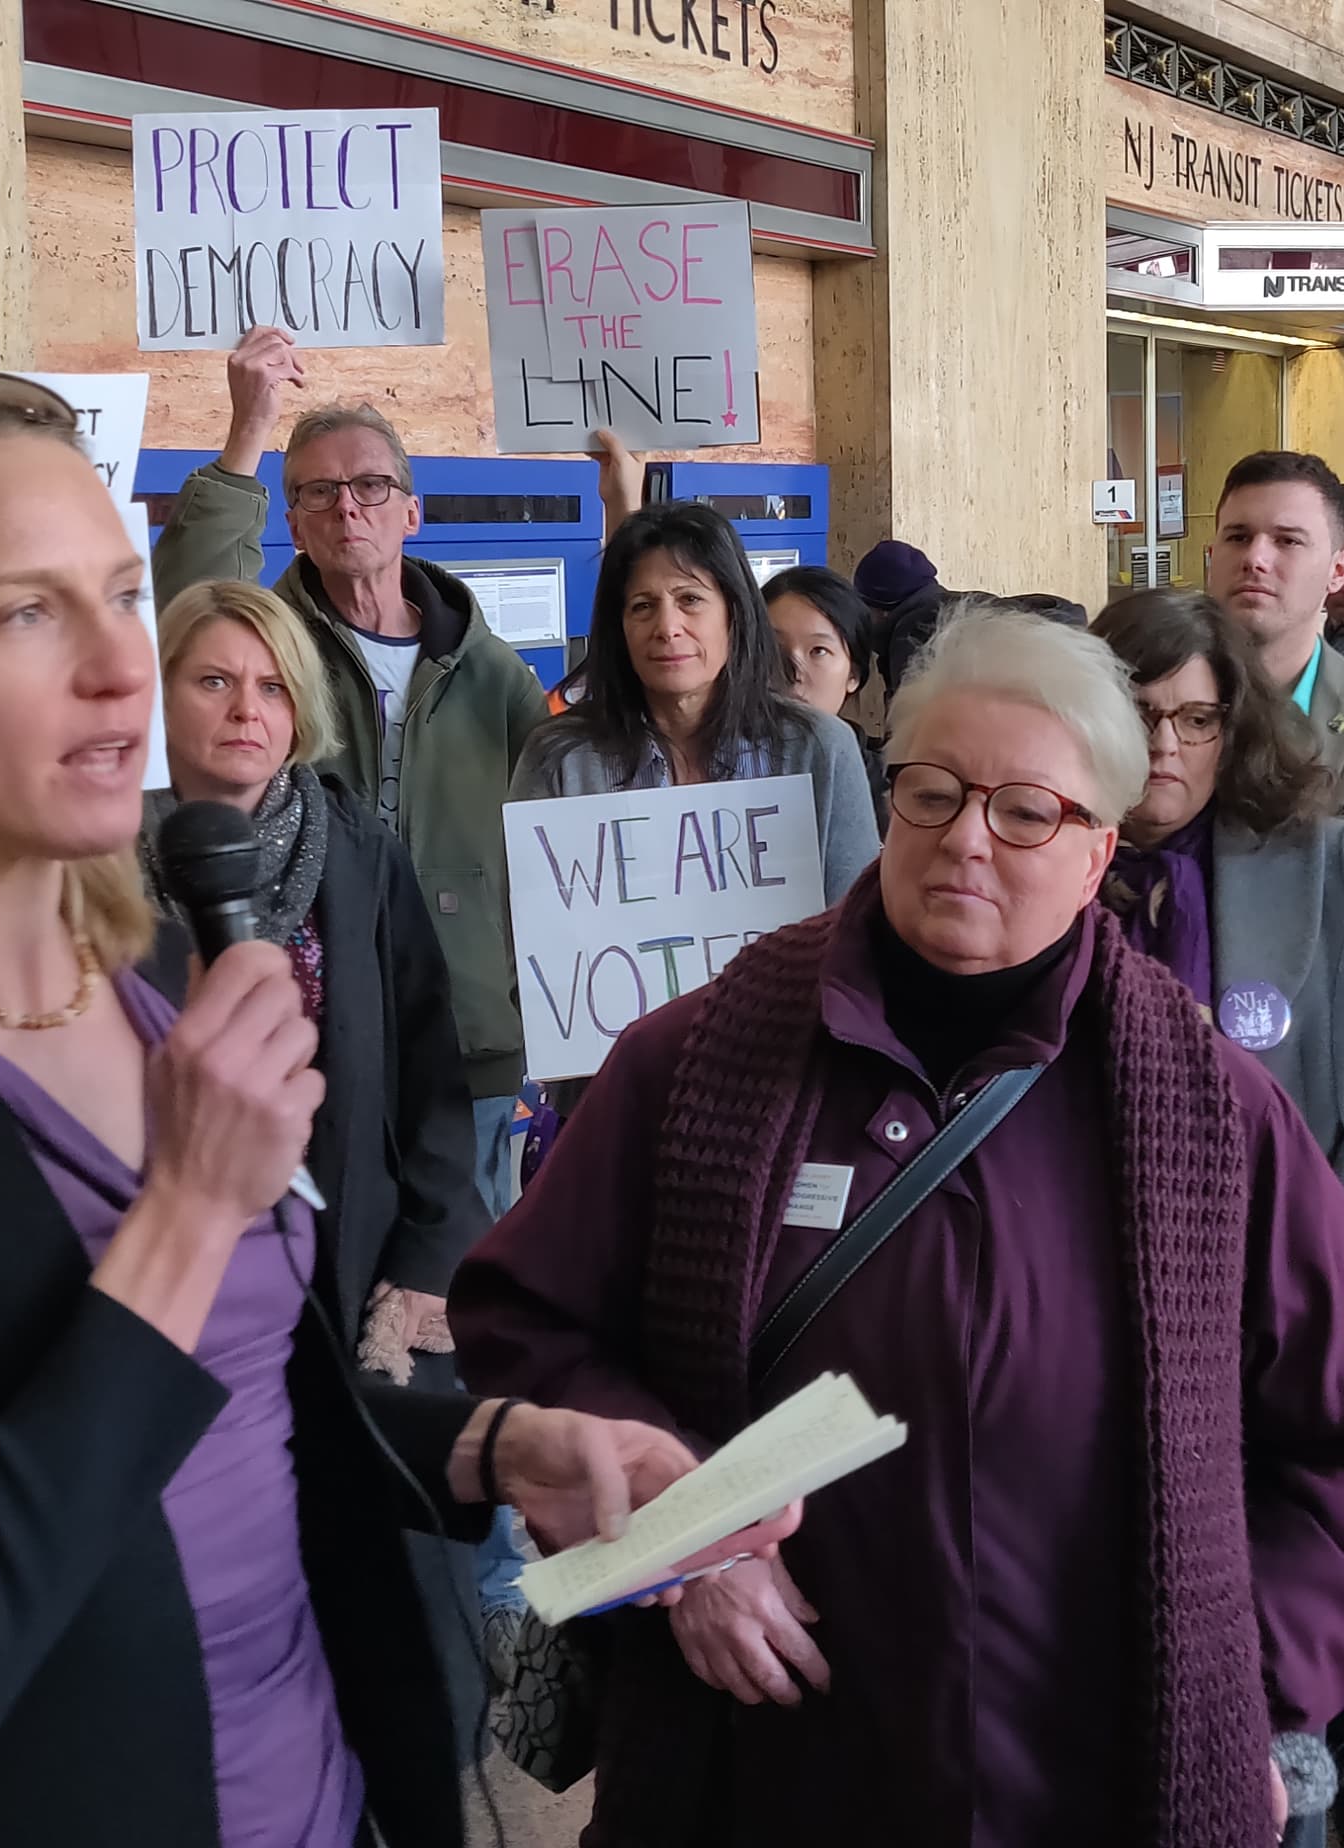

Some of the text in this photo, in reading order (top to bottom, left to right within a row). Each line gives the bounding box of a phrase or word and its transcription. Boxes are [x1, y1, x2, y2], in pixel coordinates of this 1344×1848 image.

[153, 124, 412, 215] PROTECT
[1124, 117, 1342, 221] NJ TRANSIT TICKETS
[146, 237, 425, 337] DEMOCRACY
[504, 221, 723, 308] ERASE
[564, 315, 642, 349] THE
[522, 350, 737, 428] LINE!
[1108, 486, 1116, 503] 1
[534, 805, 785, 910] WE ARE
[528, 931, 763, 1040] VOTE
